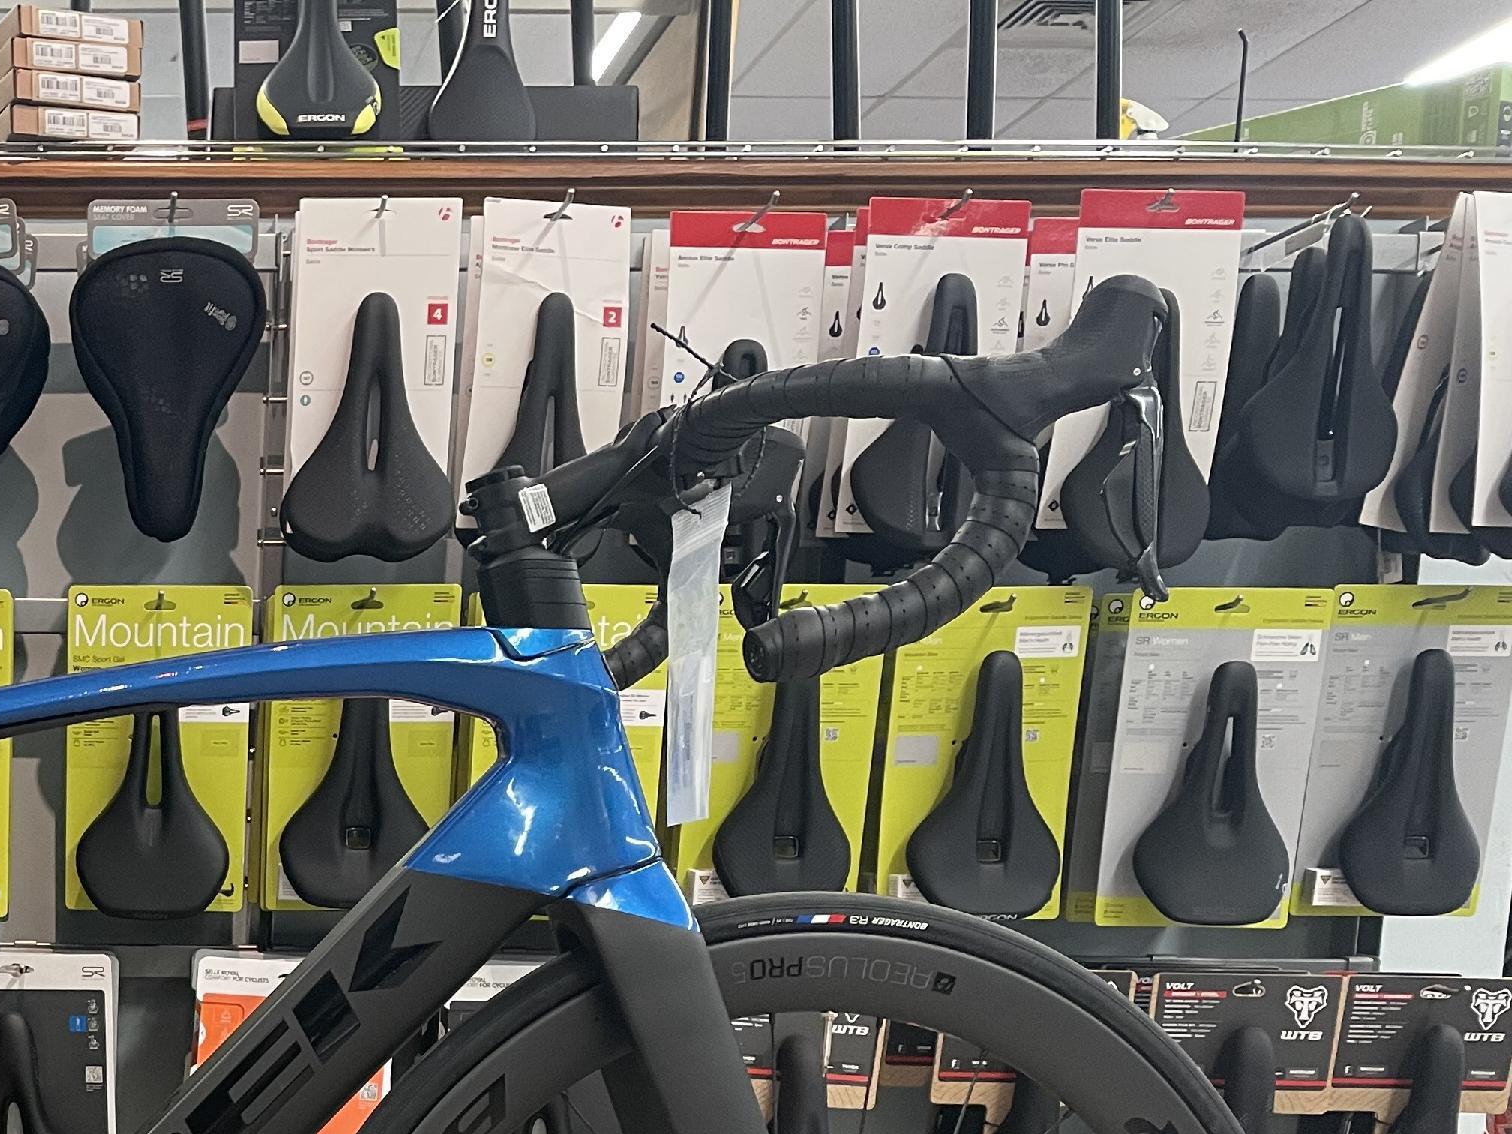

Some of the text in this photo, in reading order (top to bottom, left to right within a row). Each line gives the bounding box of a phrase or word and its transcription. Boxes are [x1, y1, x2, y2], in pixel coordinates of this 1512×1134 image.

[482, 0, 498, 38] ERG
[297, 114, 346, 122] ERGON
[93, 205, 147, 213] MEMORY FOAM
[972, 226, 1021, 234] BONTRAGER
[772, 238, 820, 246] BONTRAGER
[432, 308, 443, 320] 4
[608, 312, 616, 324] 2
[92, 597, 125, 605] ERGON
[299, 597, 332, 605] ERGON
[75, 613, 245, 648] Mountain
[283, 613, 455, 640] Mountain
[1135, 636, 1189, 645] SR Women
[1335, 632, 1349, 641] SR
[92, 656, 112, 664] Sport
[849, 915, 929, 931] BONTRAGER R3
[1166, 982, 1195, 990] VOLT
[831, 1024, 870, 1036] WTB
[1281, 1030, 1324, 1041] WTB
[1464, 1032, 1506, 1042] WTB
